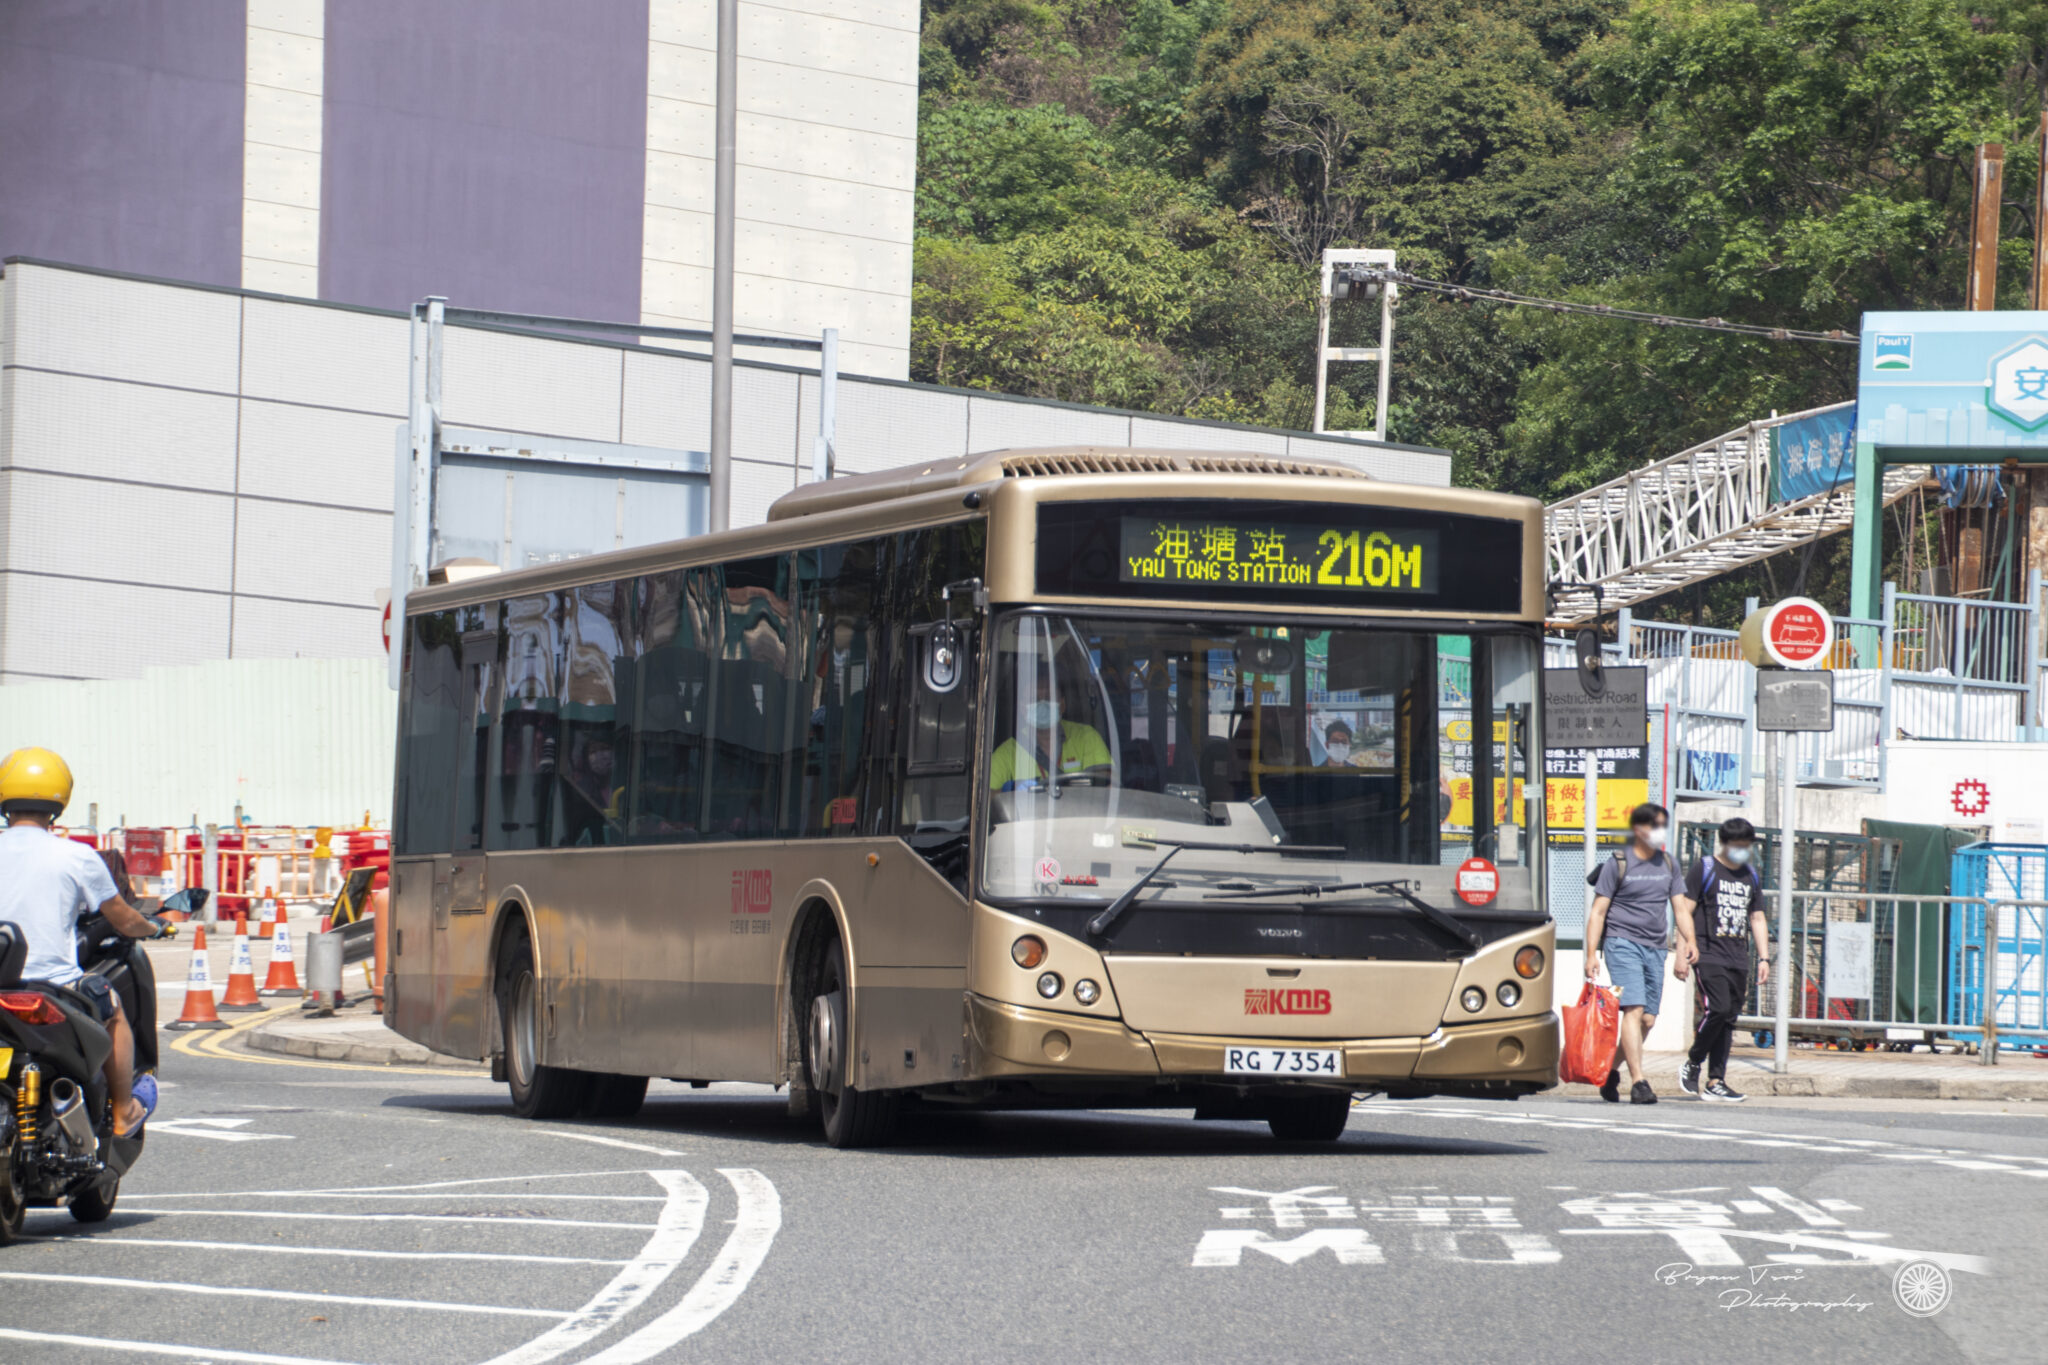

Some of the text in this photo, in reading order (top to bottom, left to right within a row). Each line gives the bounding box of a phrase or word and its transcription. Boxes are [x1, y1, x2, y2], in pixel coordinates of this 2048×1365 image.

[1878, 337, 1900, 346] Paul
[2014, 366, 2048, 400] 安
[1151, 523, 1287, 563] 油塘站
[1128, 557, 1311, 584] YAU TONG STATION
[1317, 529, 1422, 588] 216M
[1606, 691, 1638, 704] Road
[1042, 862, 1055, 878] K
[743, 868, 772, 914] KMB
[1719, 879, 1751, 896] HUEY
[1716, 893, 1751, 908] DEWEY
[1257, 928, 1303, 937] VOLVO
[1269, 988, 1332, 1015] KMB
[1230, 1050, 1336, 1073] RG 7354
[1191, 1226, 1902, 1267] SLOW
